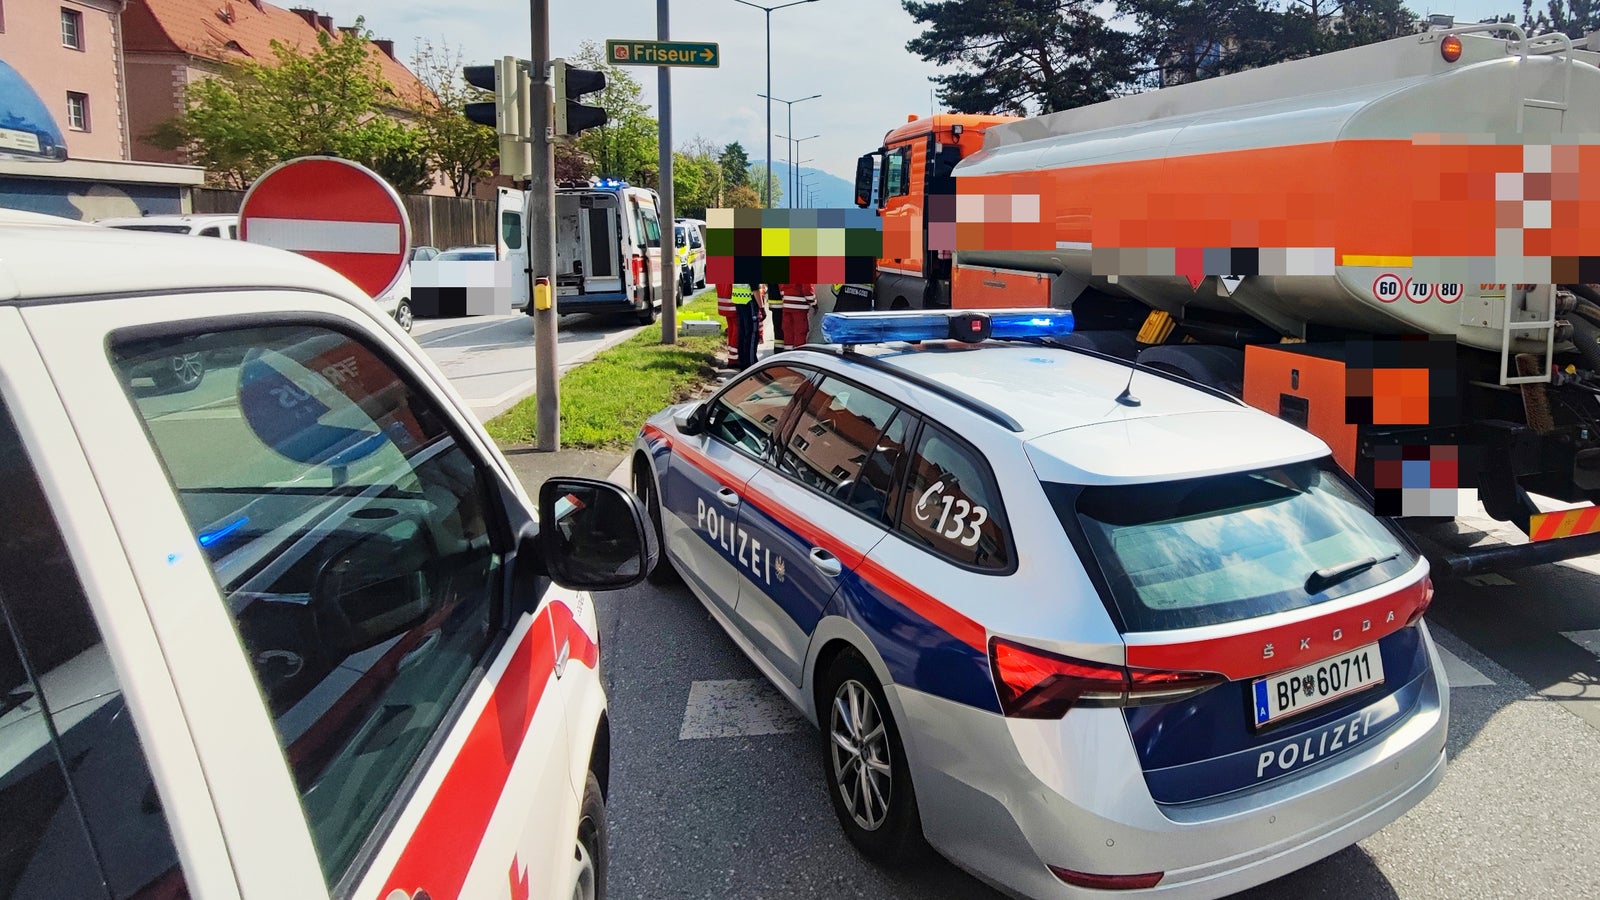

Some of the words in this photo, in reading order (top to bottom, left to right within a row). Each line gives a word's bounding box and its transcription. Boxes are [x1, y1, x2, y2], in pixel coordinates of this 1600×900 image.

[633, 44, 697, 62] Friseur
[1379, 281, 1397, 295] 60
[1412, 283, 1427, 296] 70
[1441, 283, 1457, 296] 80
[936, 495, 988, 546] 133
[697, 496, 771, 585] POLIZEI
[1277, 676, 1300, 711] BP
[1316, 651, 1371, 696] 60711
[1259, 706, 1267, 717] A
[1256, 711, 1373, 778] POLIZEI
